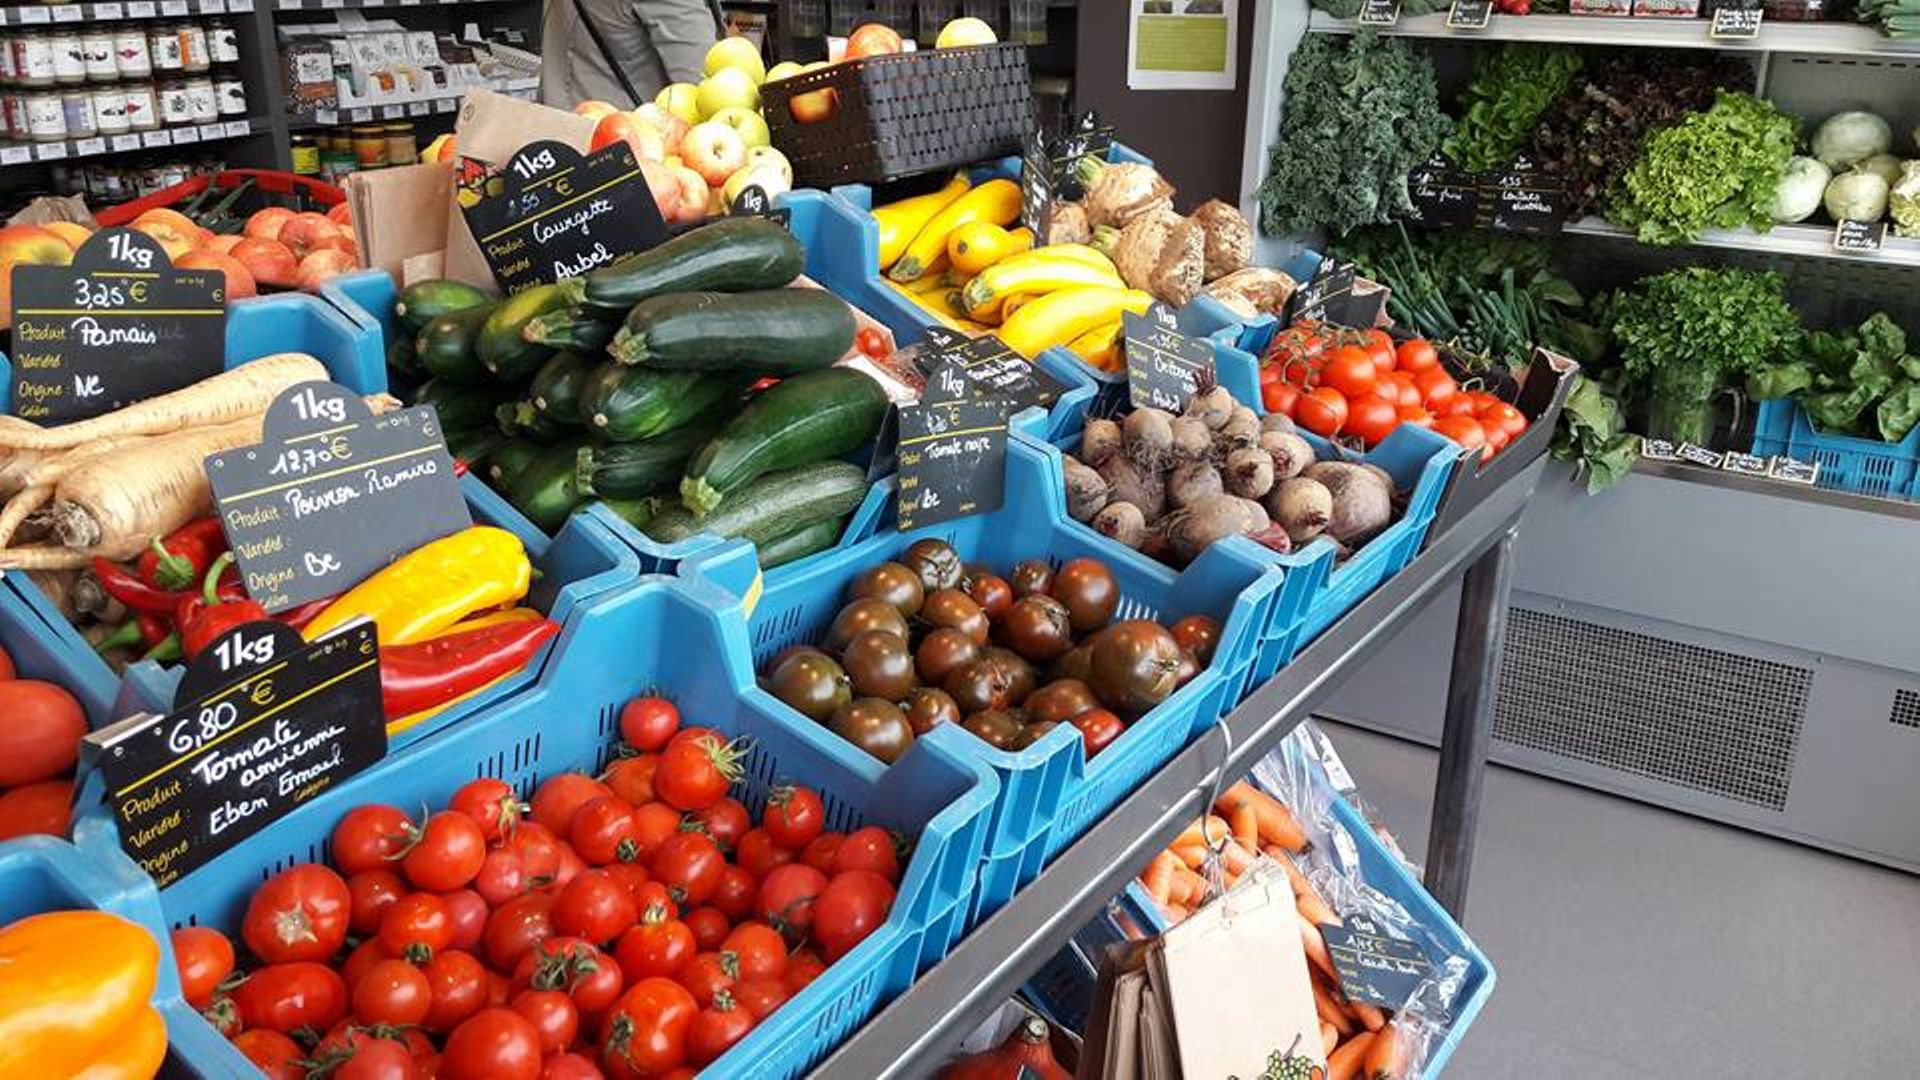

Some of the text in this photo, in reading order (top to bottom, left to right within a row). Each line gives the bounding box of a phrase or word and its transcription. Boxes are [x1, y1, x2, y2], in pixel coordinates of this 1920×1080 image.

[513, 148, 556, 179] 1kg
[554, 177, 574, 196] €
[744, 188, 762, 212] 1kg
[532, 199, 615, 244] Courgette
[107, 233, 154, 269] 1kg
[554, 242, 615, 279] Aubel
[74, 278, 125, 310] 3,25
[129, 281, 148, 302] €
[18, 317, 157, 346] Produit Panais
[1155, 305, 1178, 330] 1kg
[18, 380, 64, 403] Origine
[940, 368, 964, 398] 1kg
[290, 388, 346, 423] 1kg
[270, 437, 352, 475] 12,70 €
[227, 459, 438, 530] Produit Poivron Ramiro
[248, 551, 342, 592] Origine Be
[214, 630, 276, 672] 1kg
[168, 678, 276, 754] 6,80 €
[120, 719, 301, 822] Produit Tomate
[129, 809, 182, 849] Variété
[137, 839, 189, 873] Origine
[209, 796, 269, 836] Eben
[1350, 916, 1377, 934] 1kg
